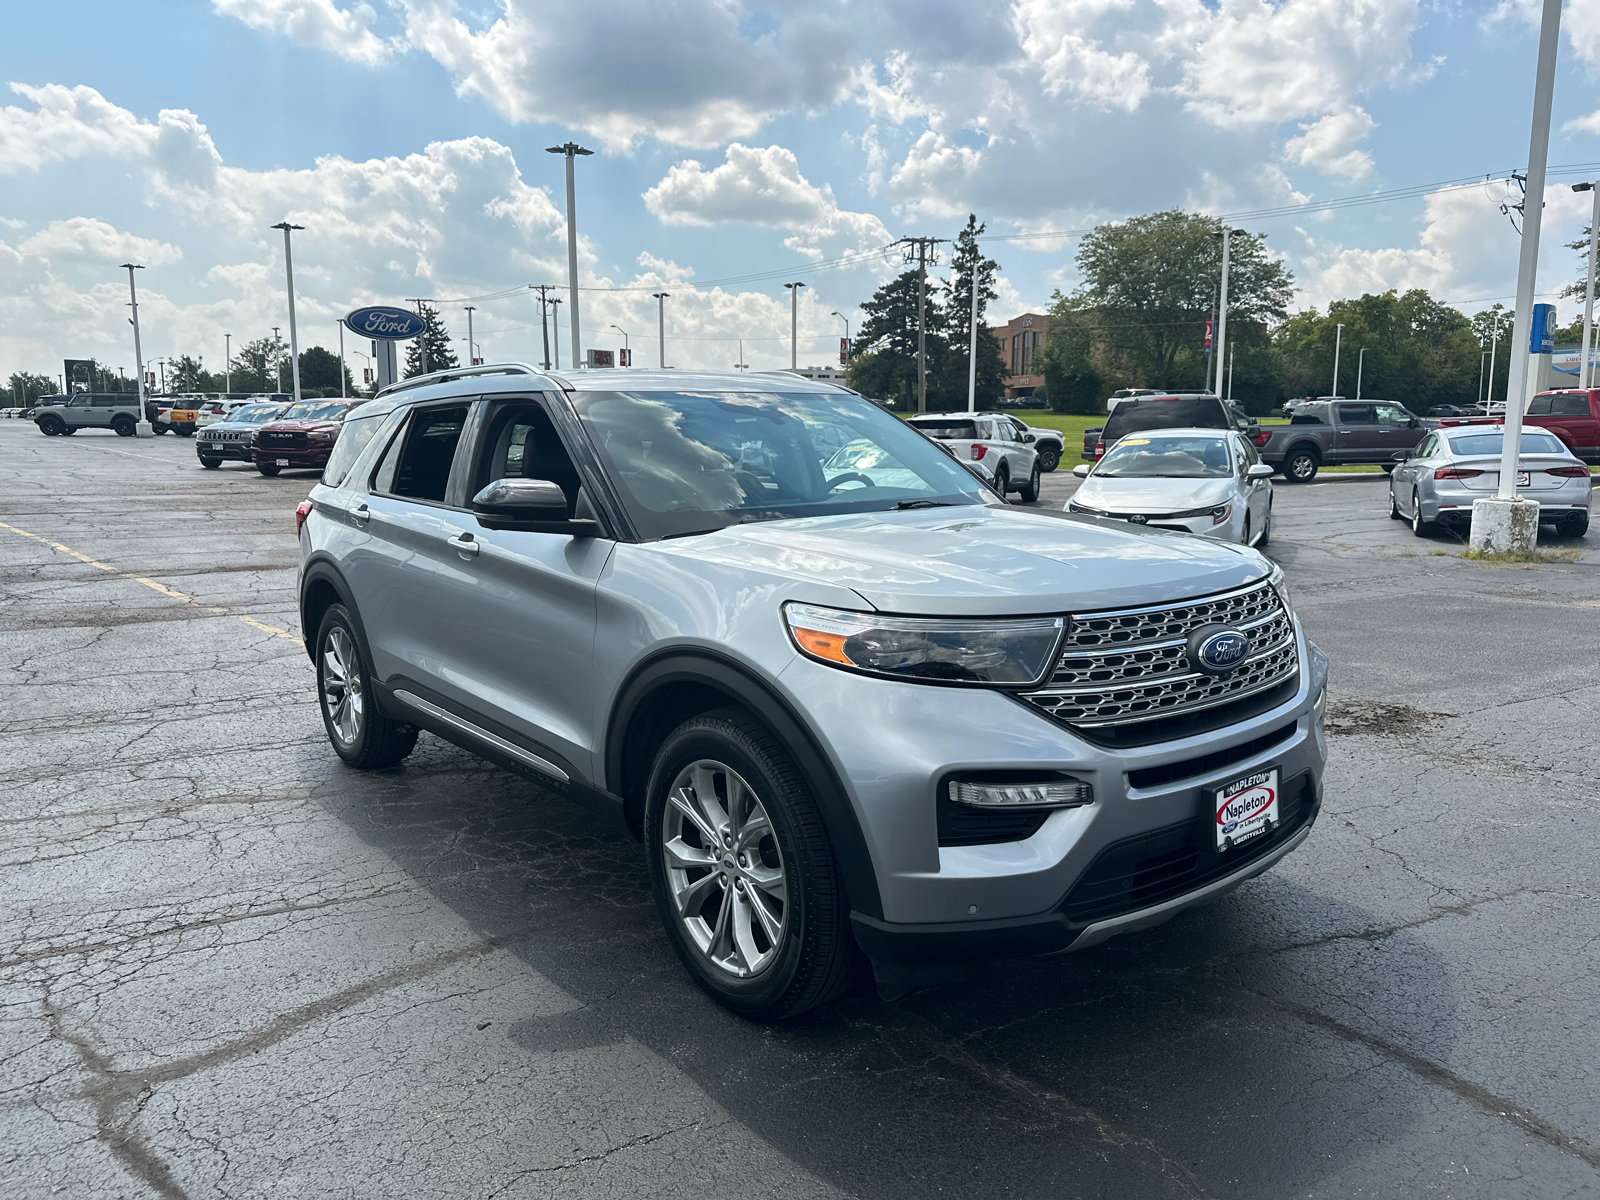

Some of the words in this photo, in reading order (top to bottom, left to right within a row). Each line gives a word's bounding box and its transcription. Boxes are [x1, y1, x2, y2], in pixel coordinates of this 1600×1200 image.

[364, 311, 411, 333] Ford
[1215, 639, 1242, 662] Ford
[1229, 773, 1266, 796] NAPLETON
[1225, 795, 1266, 820] Napleton
[1244, 812, 1271, 827] Libertyville
[1233, 826, 1266, 845] LIBERTYVILLE
[790, 862, 800, 912] PRIMACY
